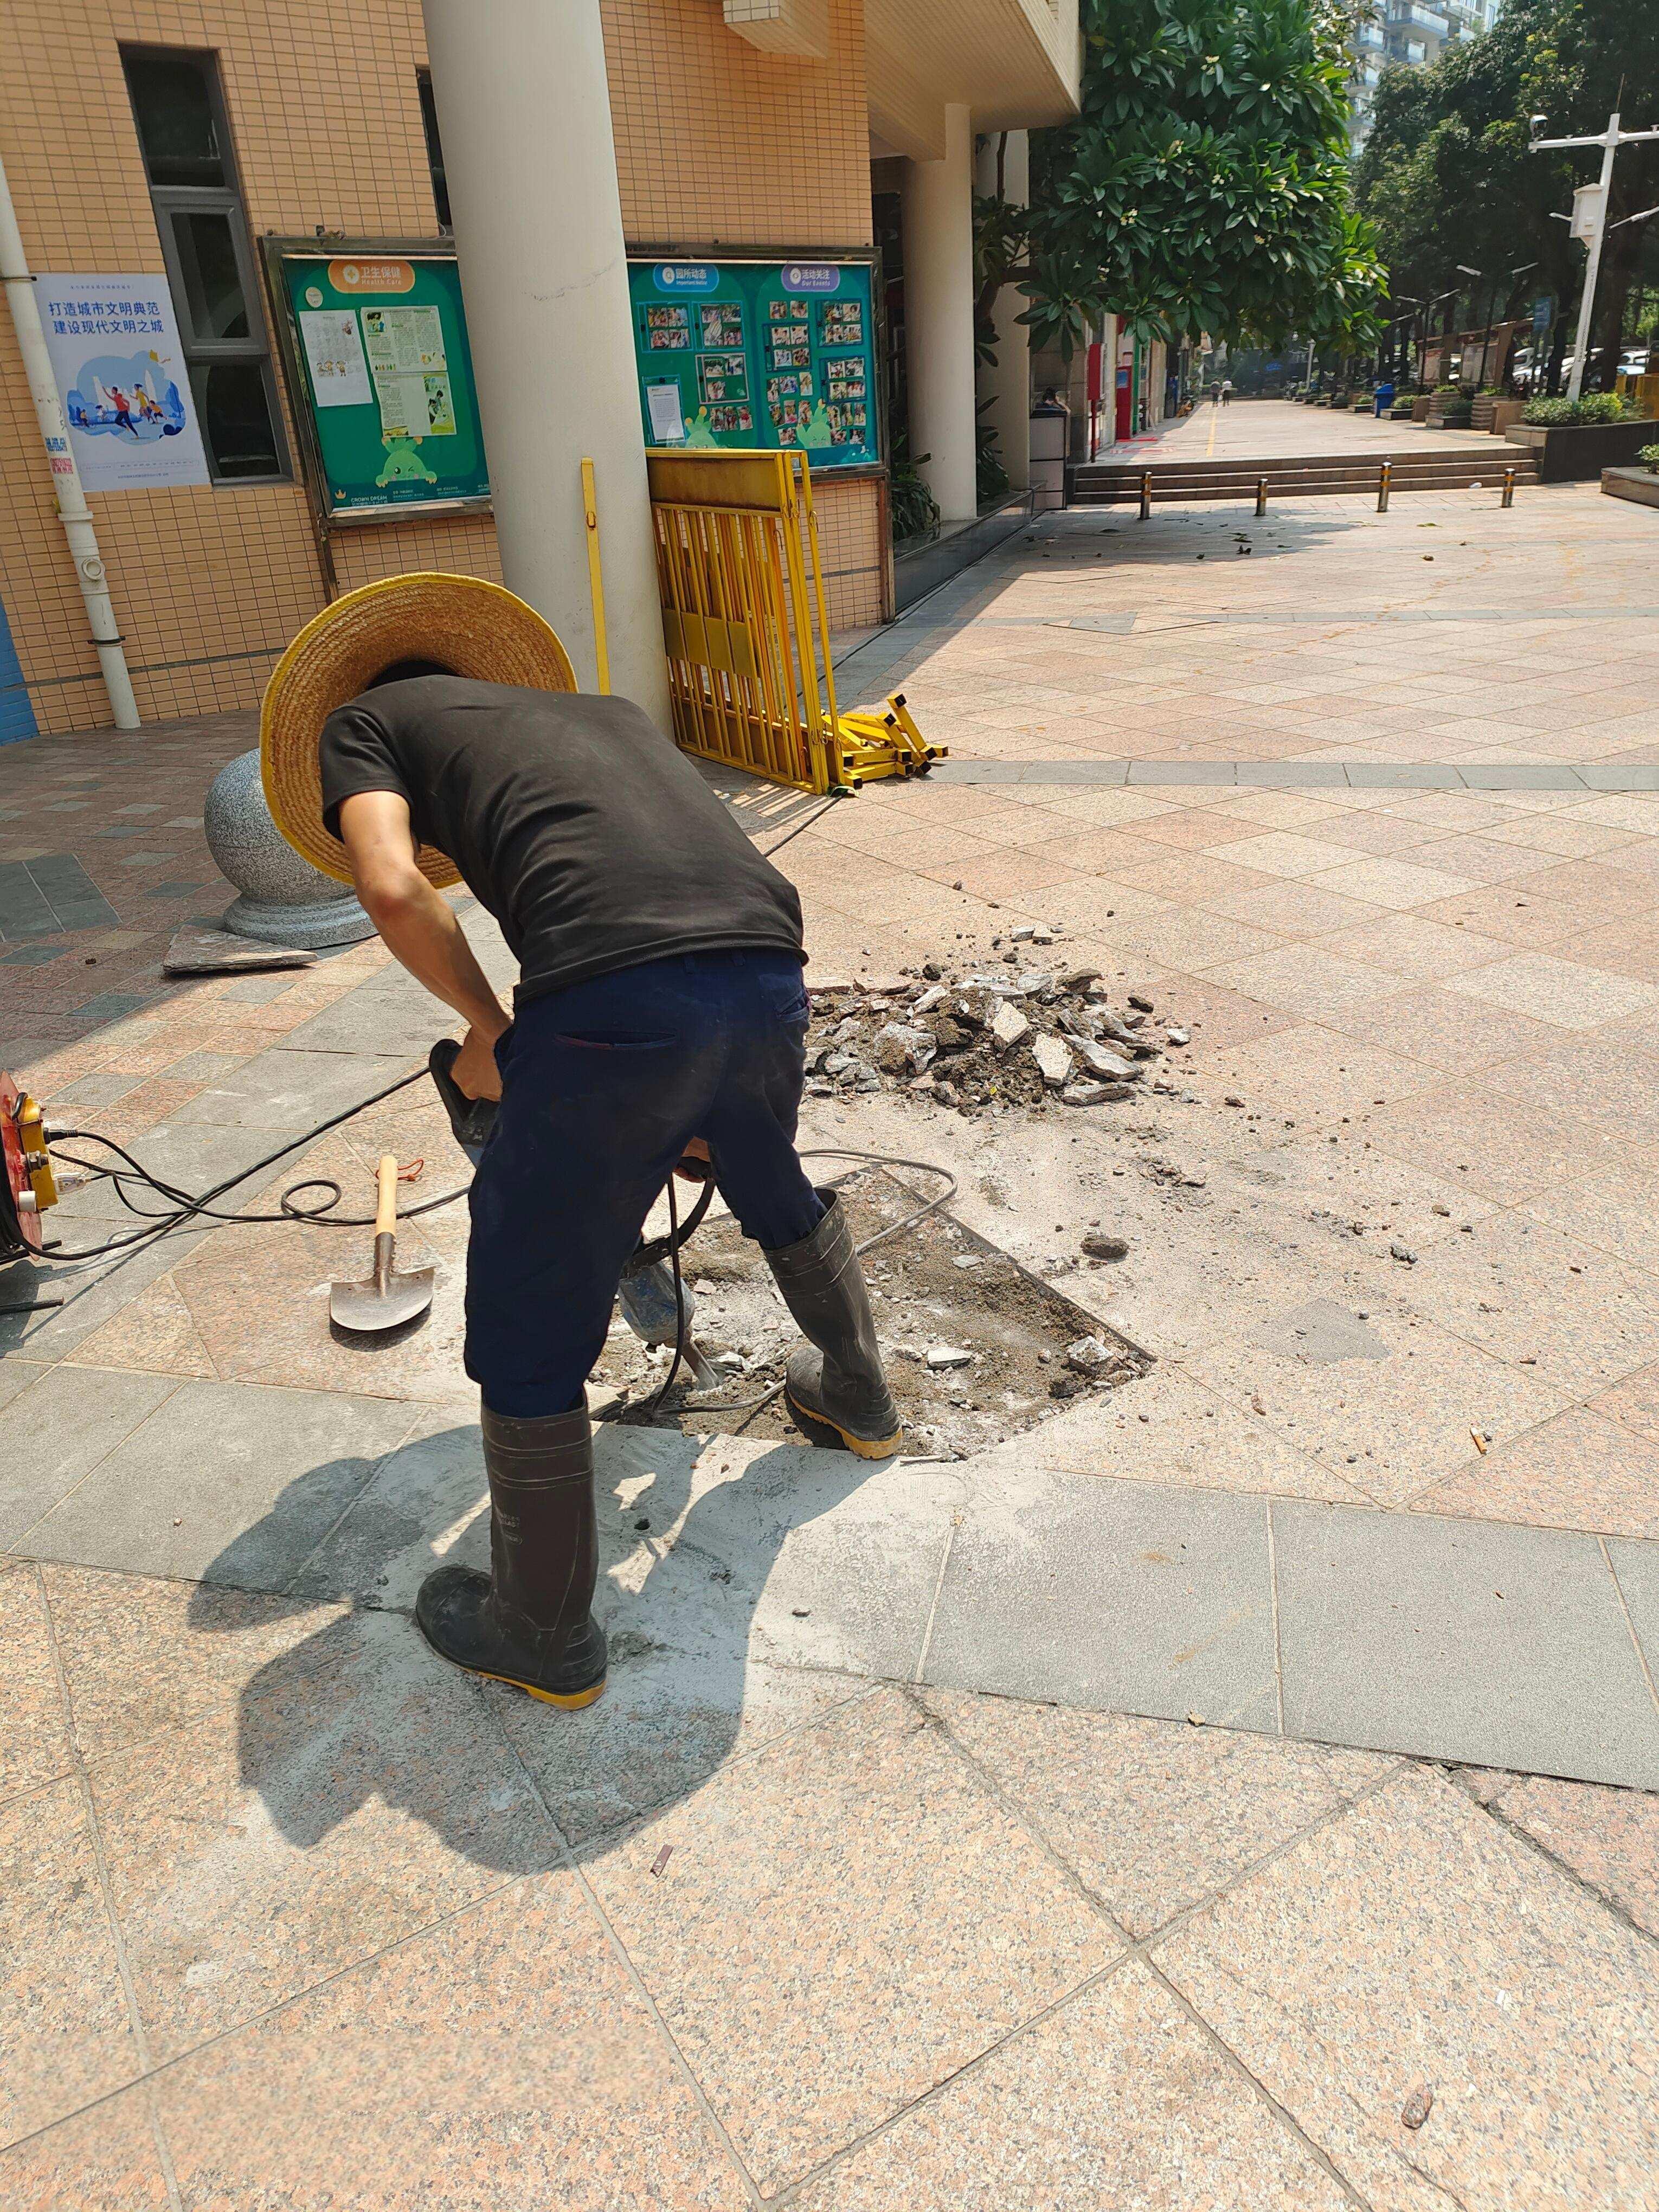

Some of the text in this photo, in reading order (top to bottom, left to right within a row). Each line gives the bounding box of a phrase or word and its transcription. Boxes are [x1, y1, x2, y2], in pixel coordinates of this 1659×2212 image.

[361, 266, 402, 279] 卫生保健
[48, 301, 160, 317] 打造城市文明典范
[53, 319, 164, 335] 建设现代文明之城
